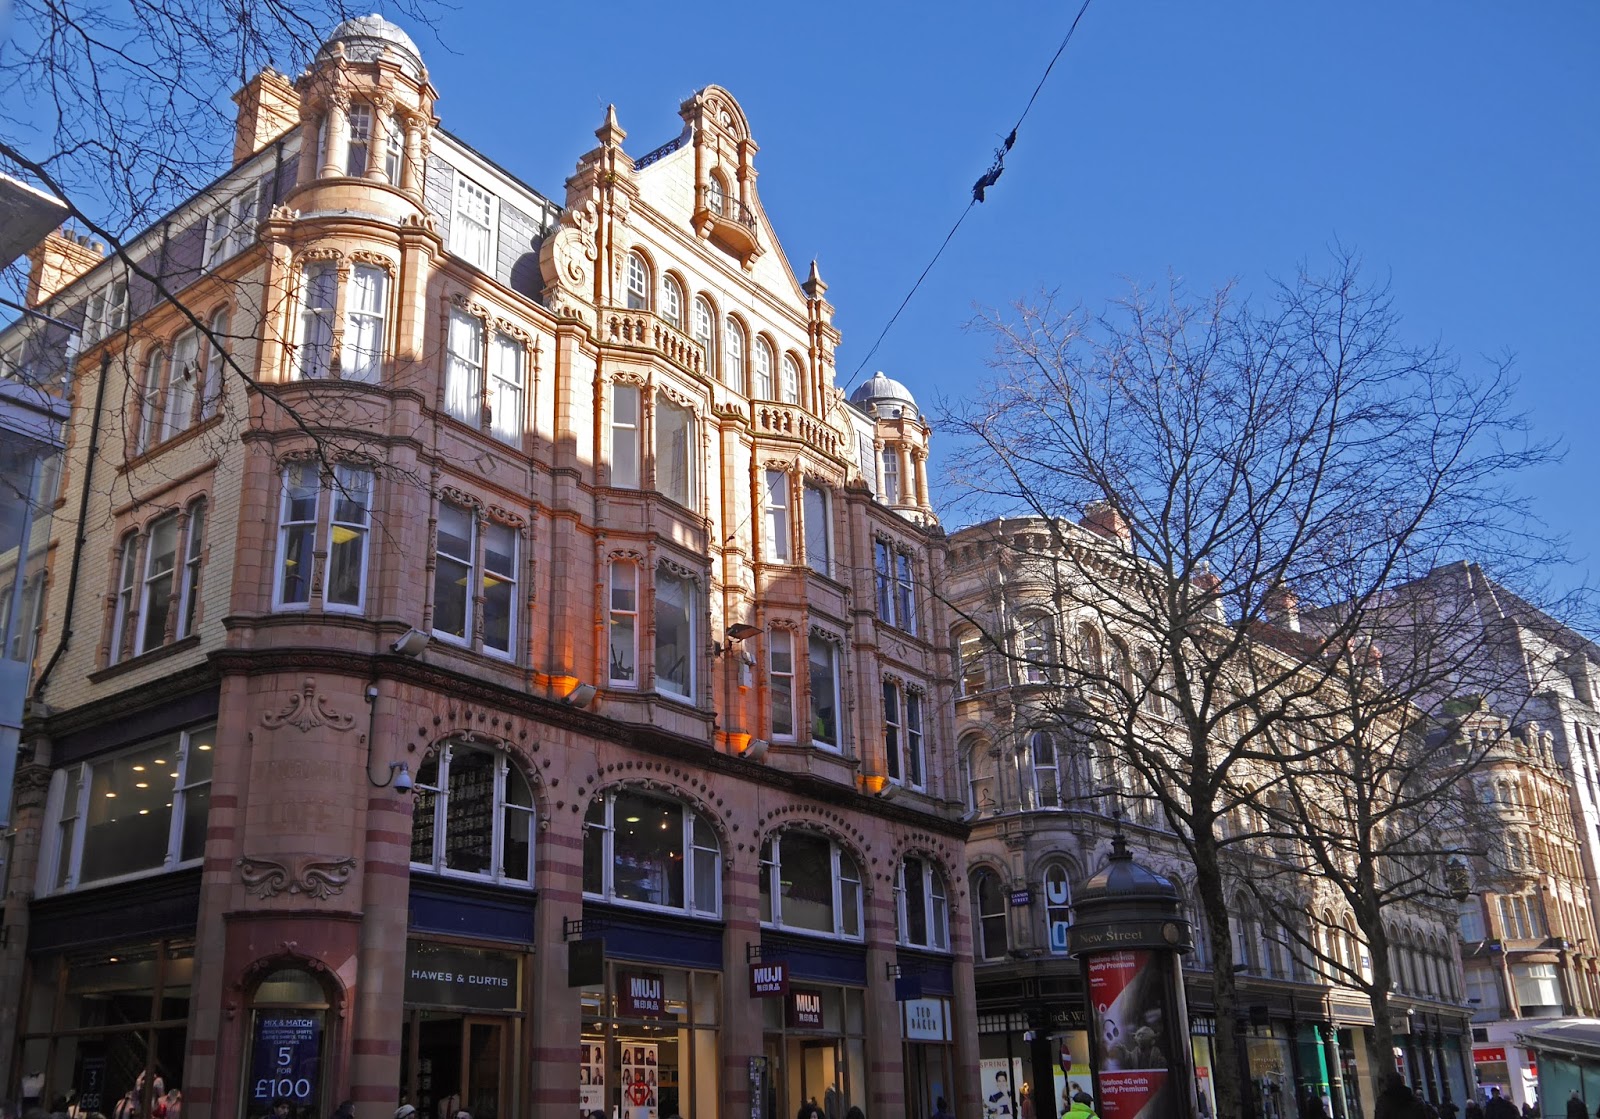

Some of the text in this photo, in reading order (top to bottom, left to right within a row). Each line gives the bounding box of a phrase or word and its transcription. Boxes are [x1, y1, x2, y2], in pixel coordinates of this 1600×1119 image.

[1011, 896, 1029, 904] STREET
[1080, 930, 1144, 943] New Street
[1106, 961, 1135, 969] Premium
[411, 970, 508, 987] HAWES & CURTIS
[753, 966, 782, 984] MUJI
[630, 977, 661, 999] MUJI
[796, 994, 820, 1013] MUJI
[916, 1006, 931, 1018] TED
[911, 1018, 937, 1031] BAKER
[277, 1047, 291, 1066] 5
[980, 1060, 1007, 1068] SPRING
[1133, 1077, 1148, 1085] with
[254, 1078, 310, 1098] £100
[1101, 1085, 1148, 1095] Spotify Premium
